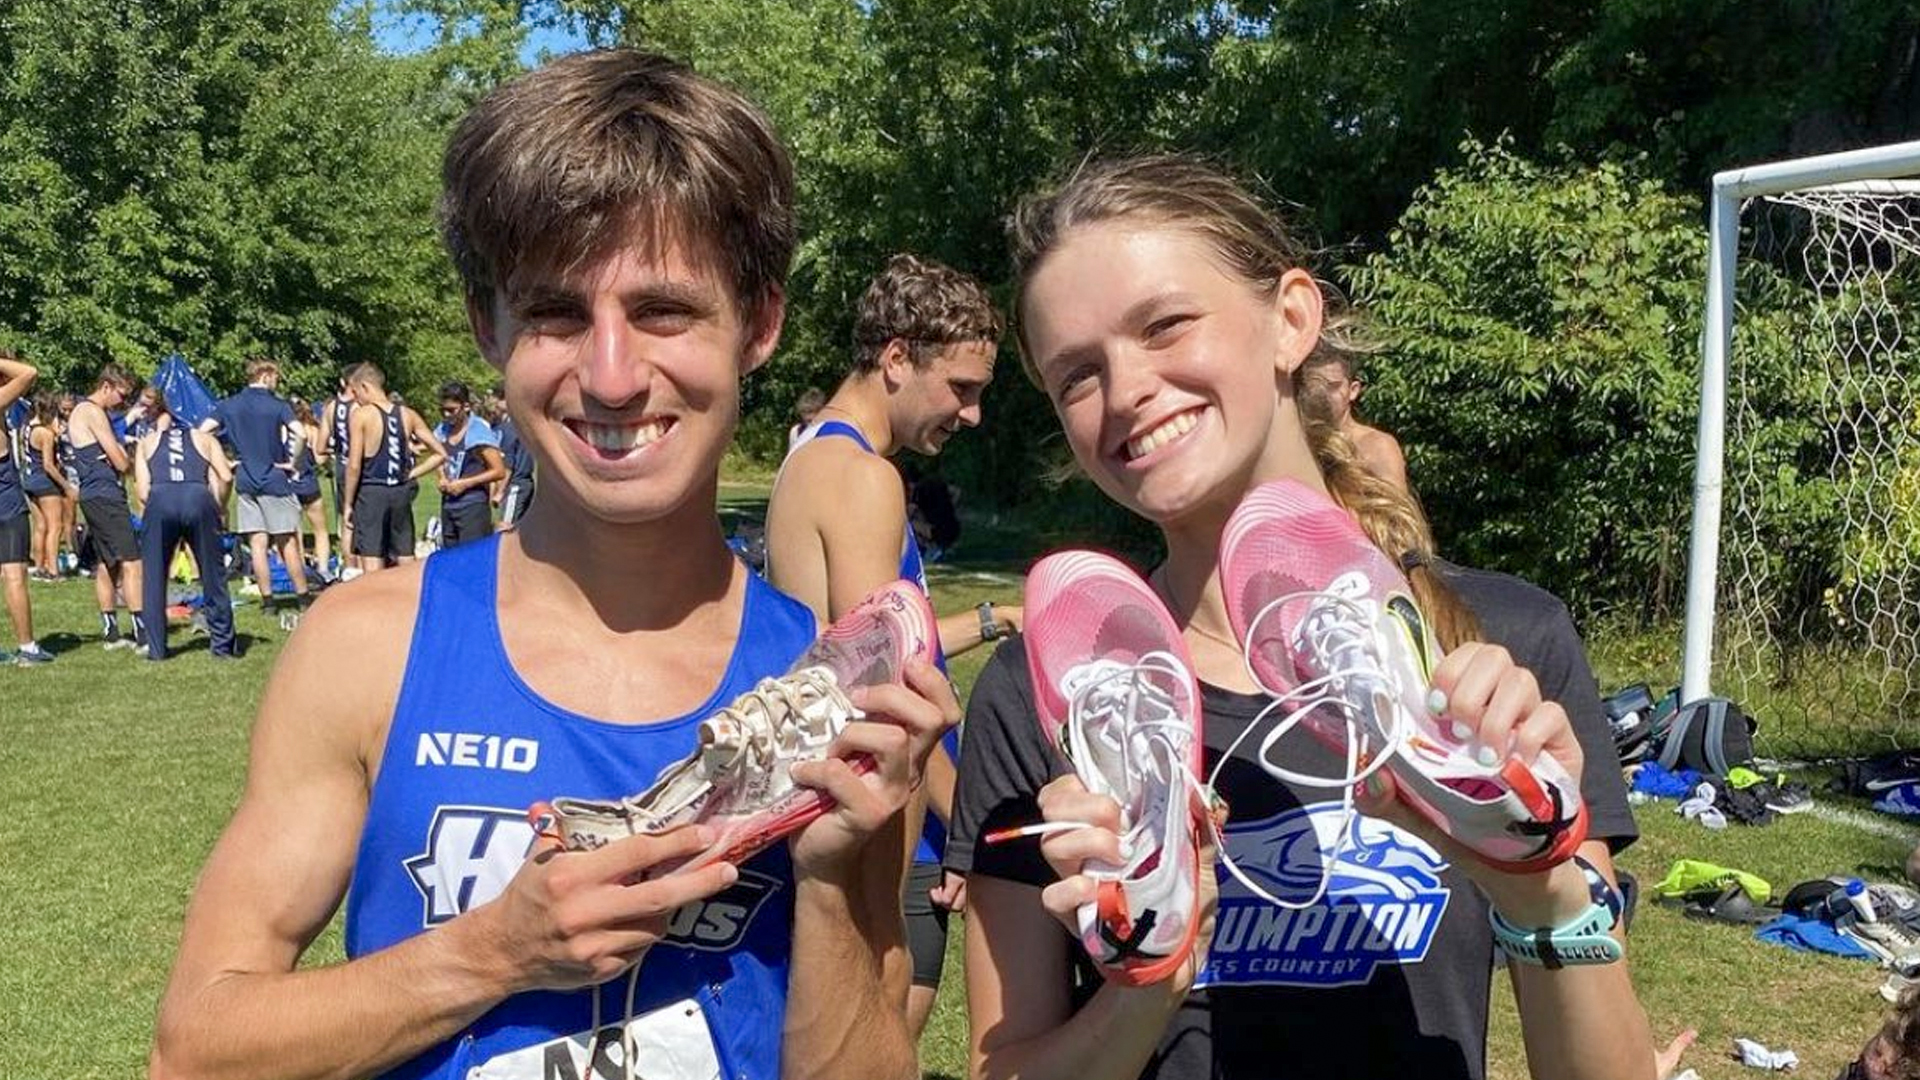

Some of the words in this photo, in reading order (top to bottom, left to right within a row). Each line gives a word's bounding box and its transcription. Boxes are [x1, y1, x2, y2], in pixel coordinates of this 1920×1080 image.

[416, 733, 539, 773] NE10
[1214, 903, 1434, 952] UMPTION
[1249, 957, 1361, 975] COUNTRY
